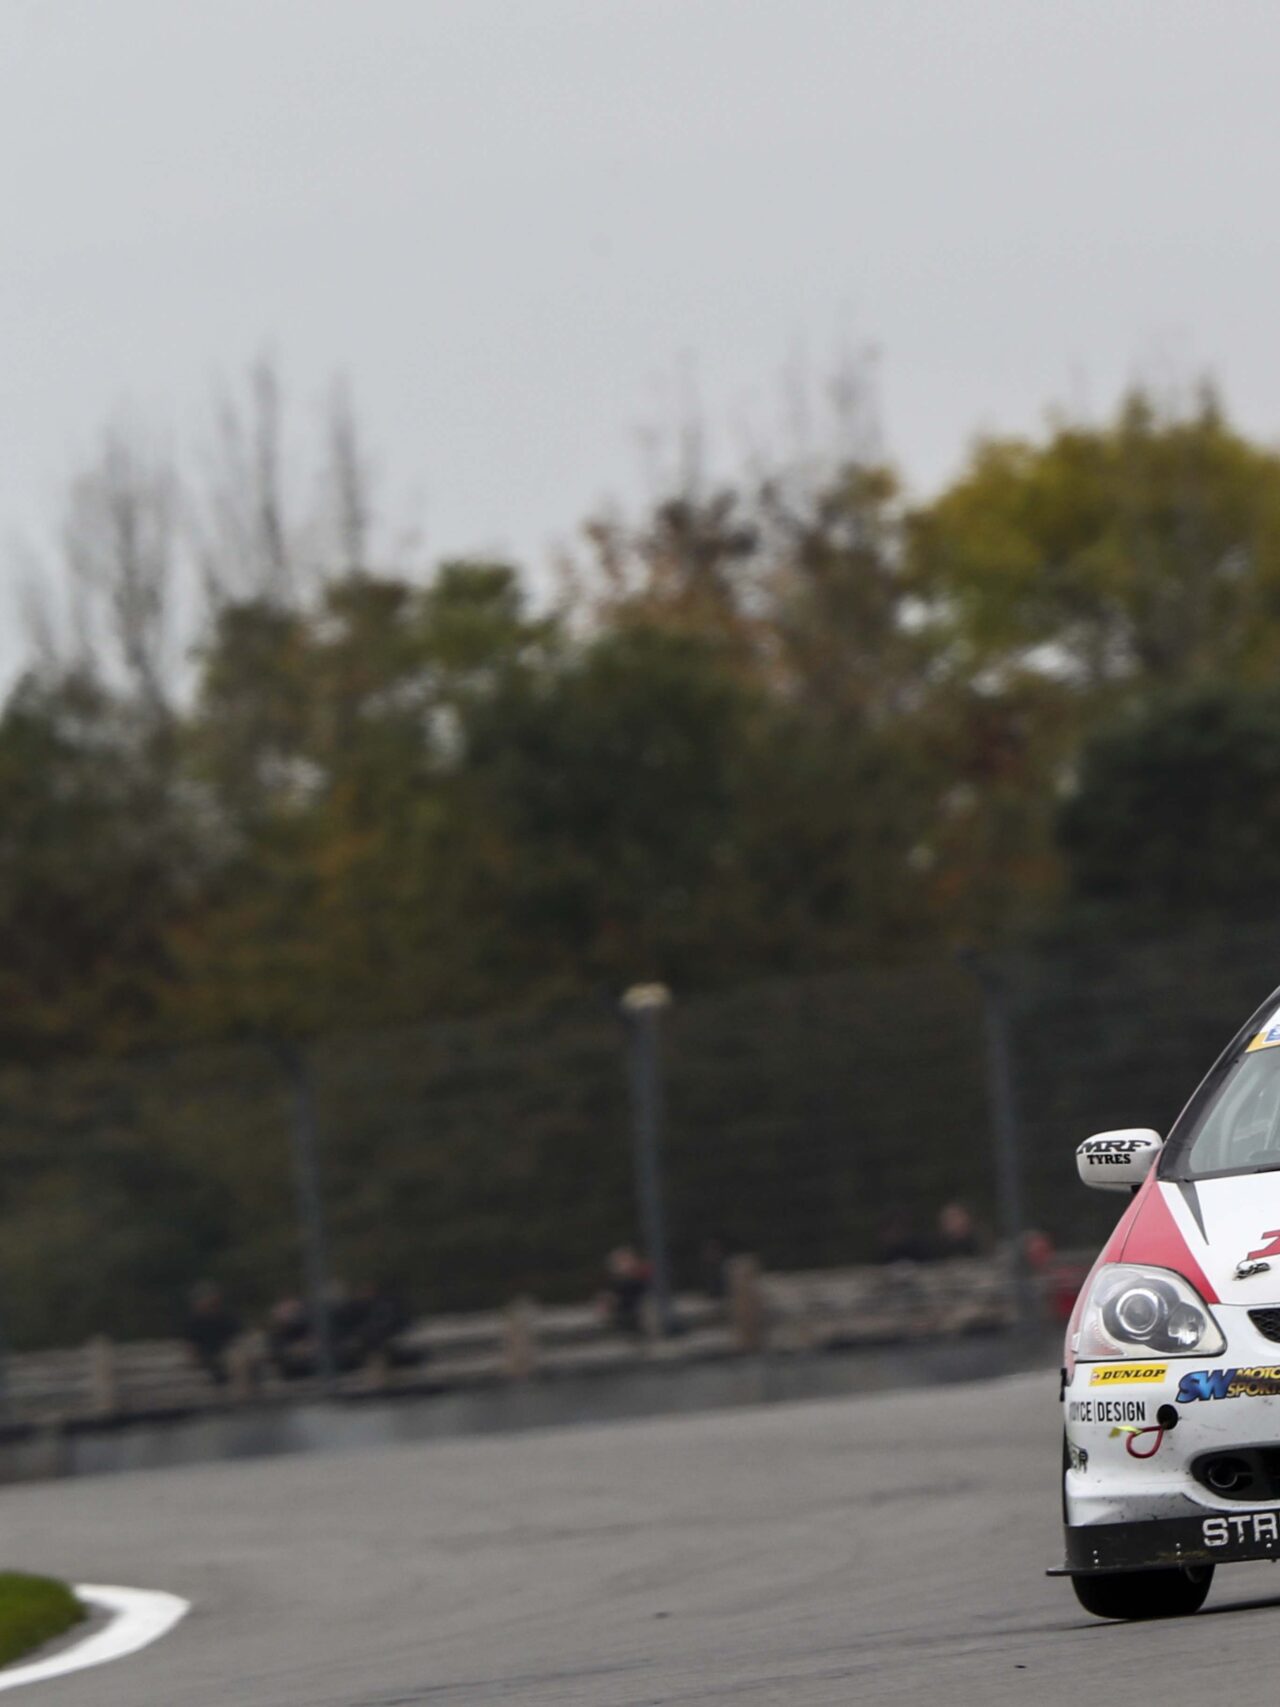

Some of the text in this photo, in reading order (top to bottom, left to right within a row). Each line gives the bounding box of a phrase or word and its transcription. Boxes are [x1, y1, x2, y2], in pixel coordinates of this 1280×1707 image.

[1076, 1139, 1152, 1155] MRF
[1086, 1153, 1132, 1165] TYRES
[1101, 1368, 1166, 1381] DUNLOP
[1175, 1368, 1237, 1404] SW
[1069, 1401, 1146, 1422] OYCE DESIGN
